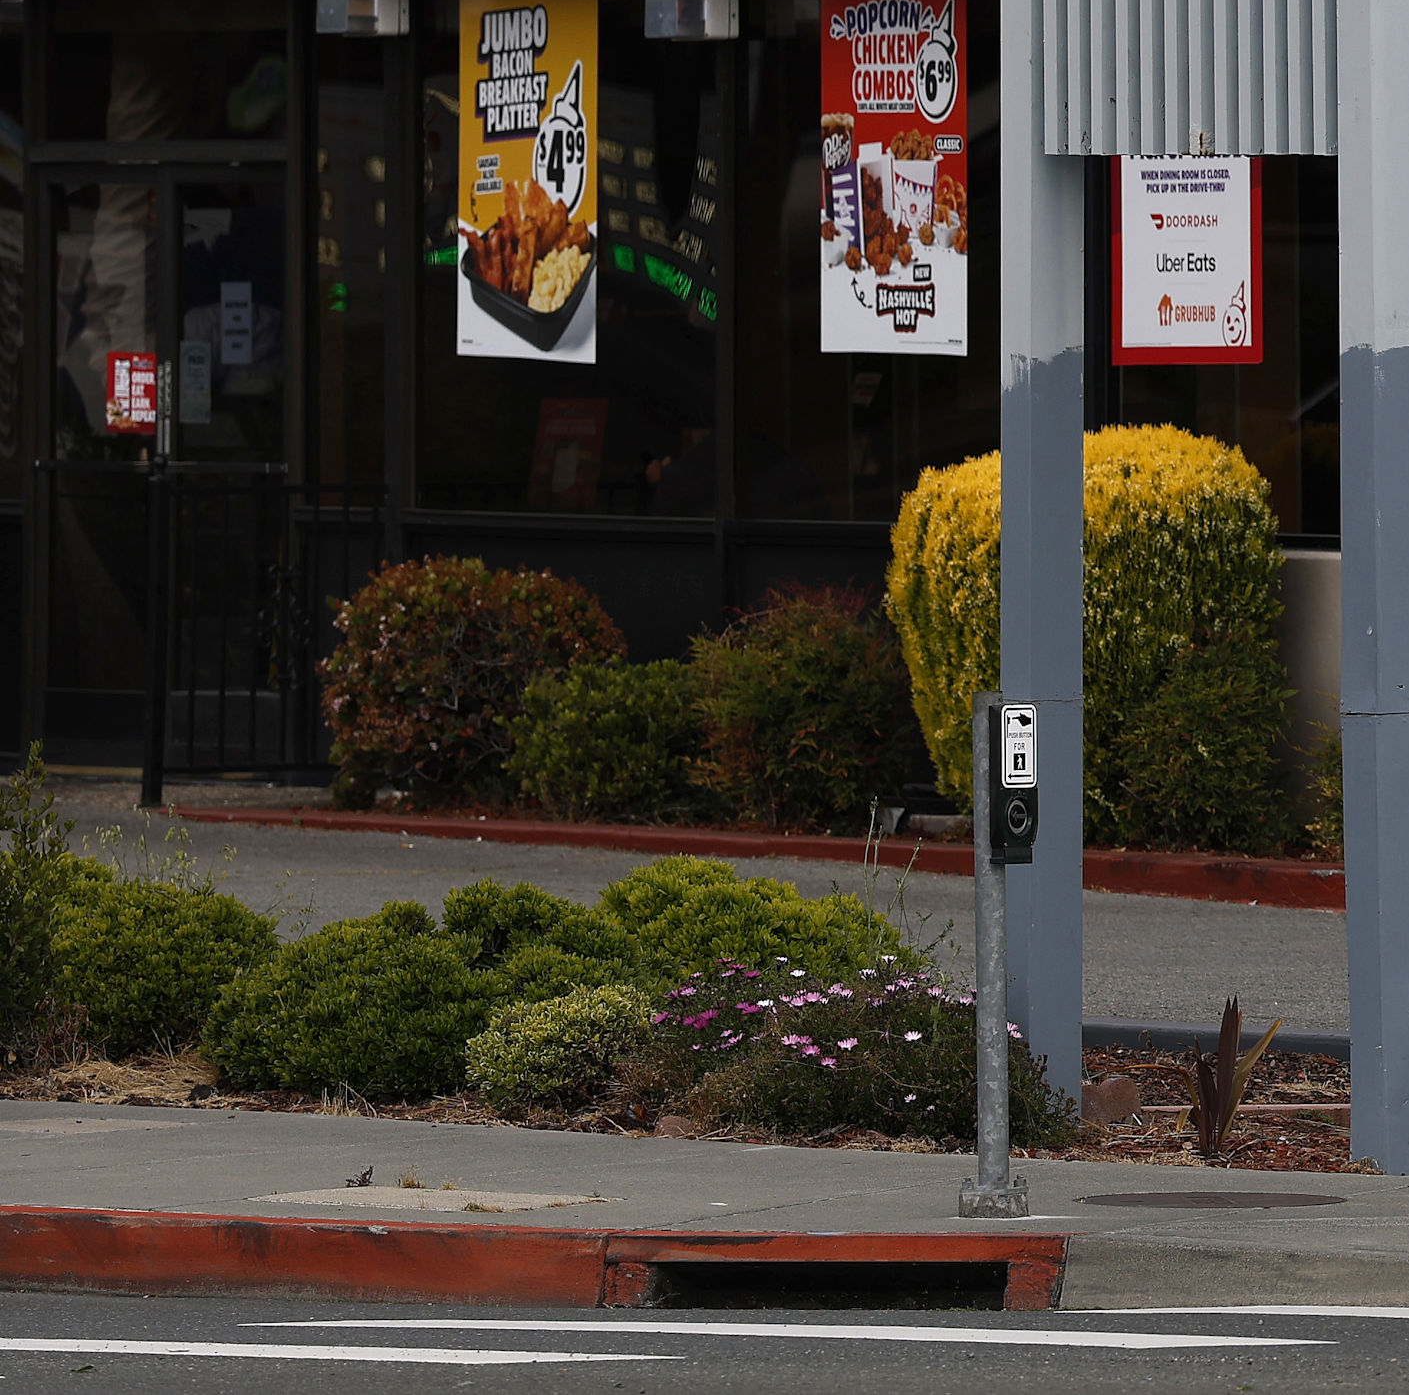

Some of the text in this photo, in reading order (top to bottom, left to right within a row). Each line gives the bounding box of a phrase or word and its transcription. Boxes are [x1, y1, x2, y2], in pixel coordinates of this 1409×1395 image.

[846, 0, 922, 38] POPCORN
[481, 6, 547, 55] JUMBO
[854, 33, 916, 65] CHICKEN
[492, 49, 533, 80] BACON
[478, 74, 548, 109] BREAKFAST
[854, 69, 915, 102] COMBOS
[487, 102, 539, 134] PLATTER
[936, 138, 961, 151] CLASSIC
[1141, 170, 1158, 180] WHEN
[1160, 170, 1180, 180] DINING
[1182, 169, 1199, 179] ROOM
[1201, 169, 1206, 179] IS
[1146, 182, 1225, 194] PICK UP IN THE DRIVE-THRU
[1166, 214, 1218, 227] DOORDASH
[1156, 253, 1216, 272] Uber Eats
[914, 267, 931, 280] NEW
[878, 287, 934, 312] NASHVILLE
[896, 309, 917, 326] HOT
[1175, 305, 1216, 323] GRUBHUB
[1013, 742, 1025, 750] FOR
